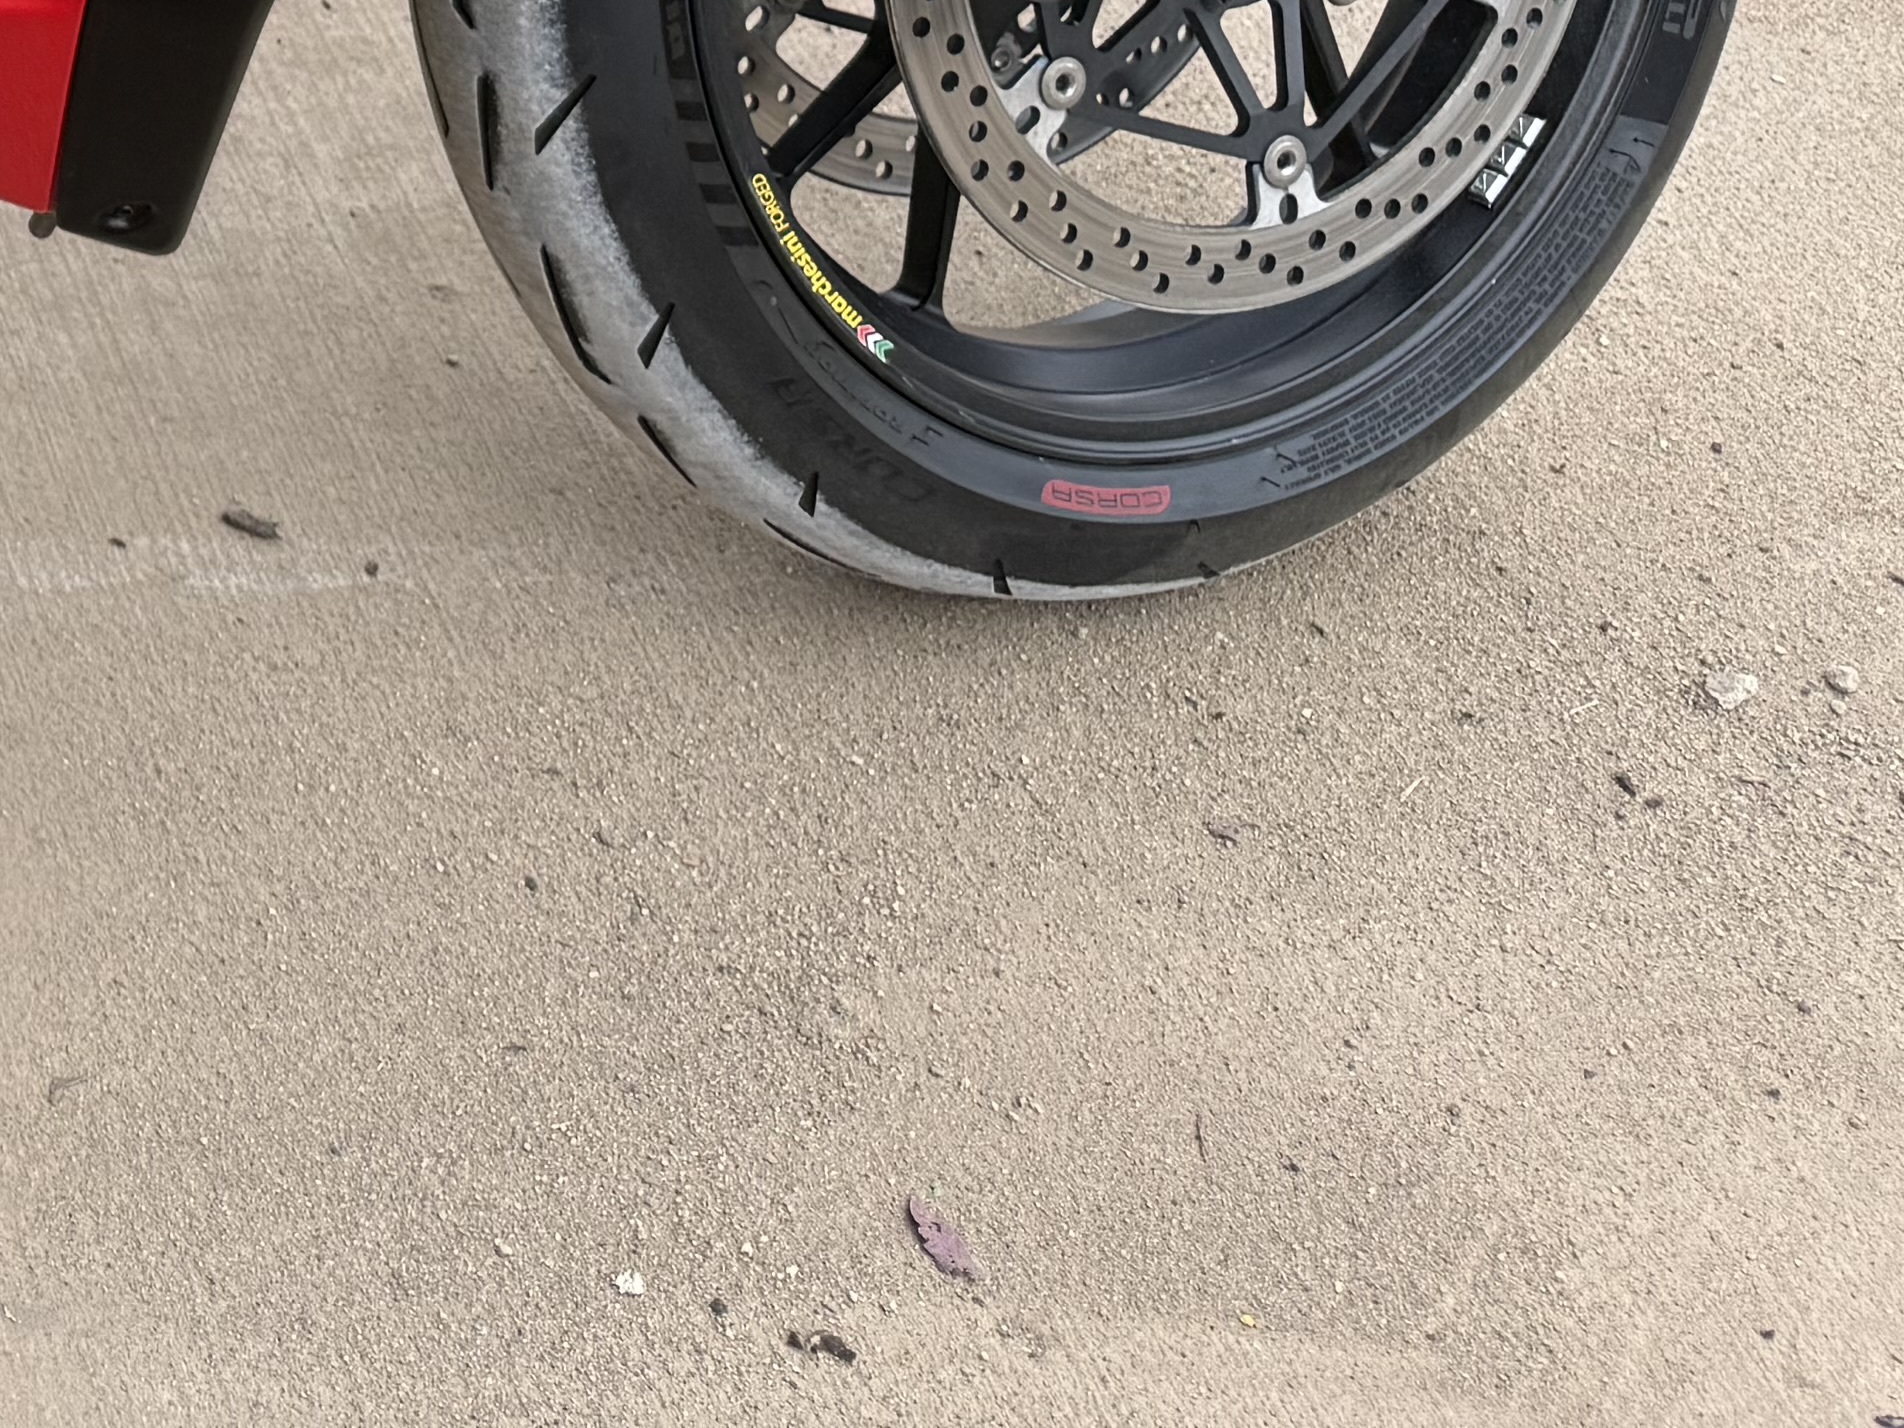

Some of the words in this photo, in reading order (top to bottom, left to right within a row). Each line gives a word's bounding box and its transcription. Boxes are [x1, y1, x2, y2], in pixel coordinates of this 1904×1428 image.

[750, 172, 788, 232] FORGED
[783, 232, 864, 328] marchesini
[1051, 482, 1163, 508] CORSA
